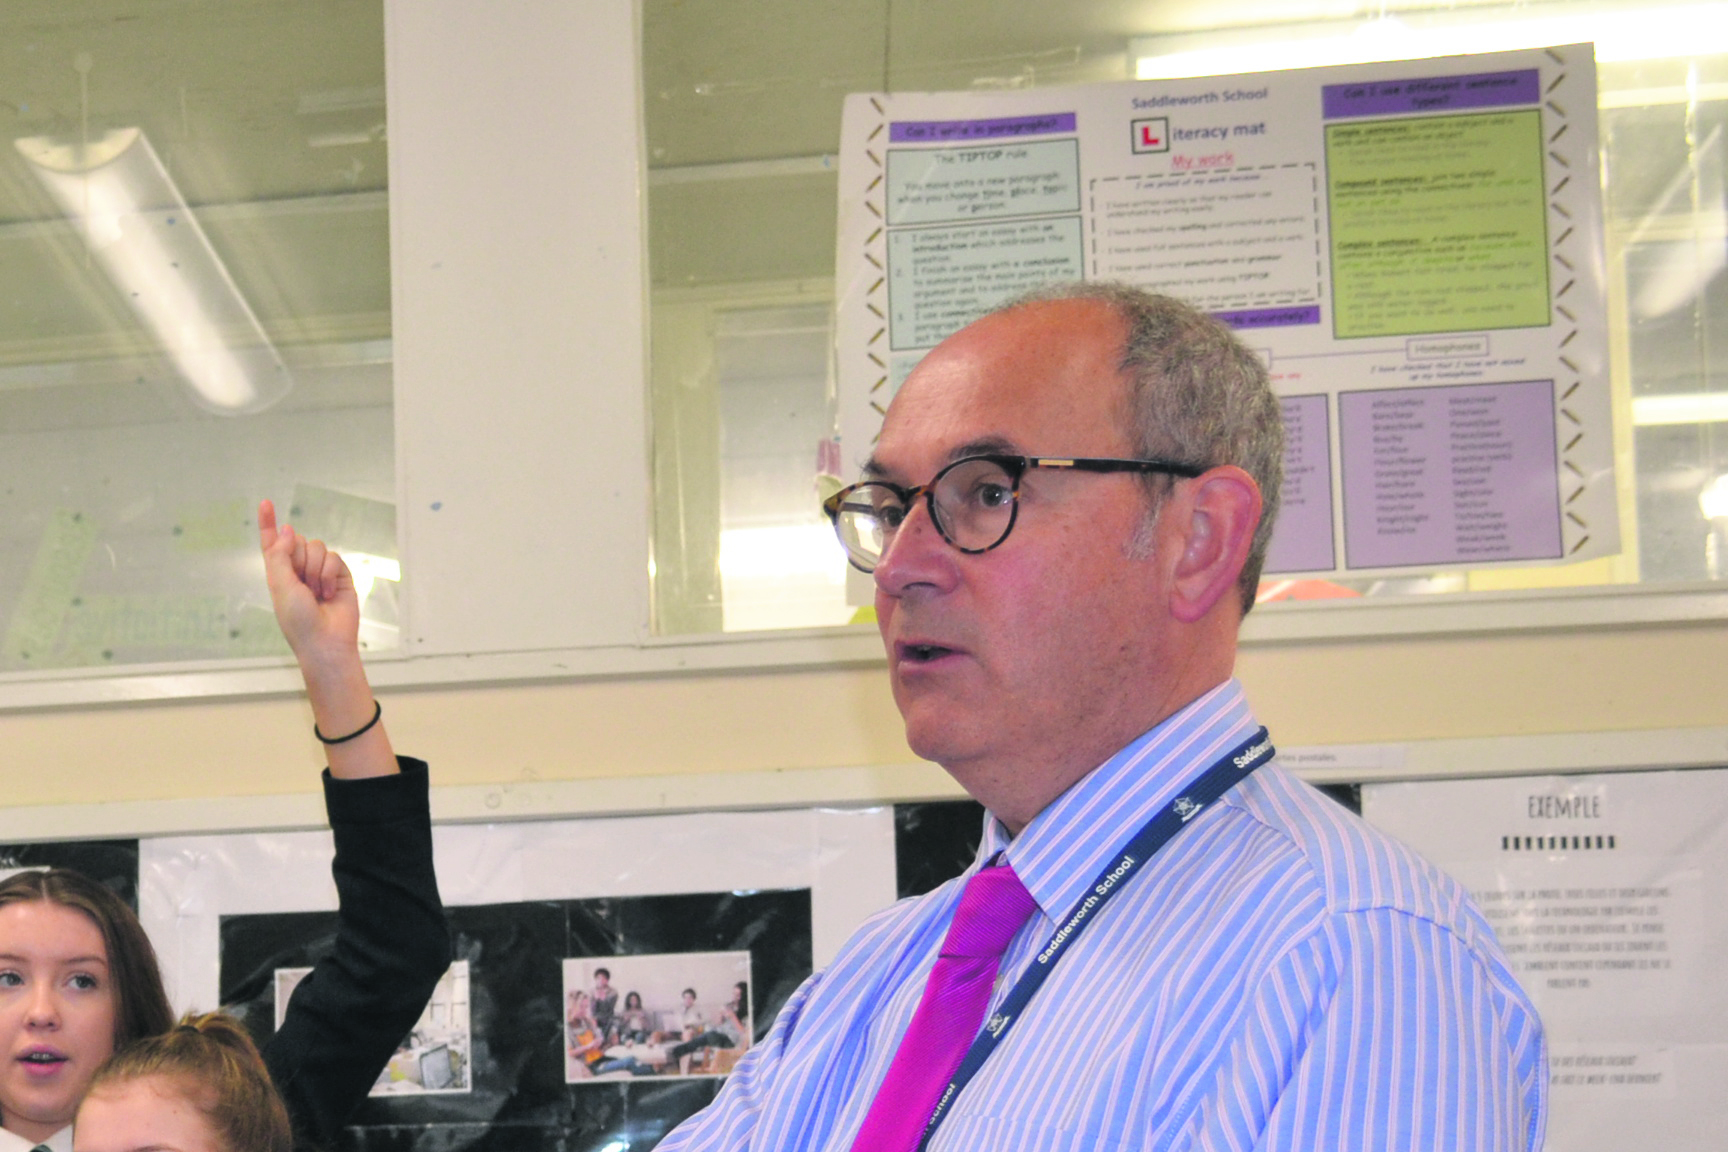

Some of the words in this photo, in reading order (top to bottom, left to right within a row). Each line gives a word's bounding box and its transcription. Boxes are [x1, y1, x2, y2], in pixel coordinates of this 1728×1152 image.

[1132, 91, 1218, 110] Saddleworth
[1221, 88, 1268, 102] School
[1141, 126, 1160, 146] L
[1172, 126, 1228, 142] iteracy
[1233, 123, 1266, 137] mat
[1172, 154, 1193, 170] My
[1198, 152, 1234, 168] work
[1528, 795, 1600, 819] EXEMPLE
[1037, 895, 1099, 964] Saddleworth
[1095, 855, 1135, 895] School
